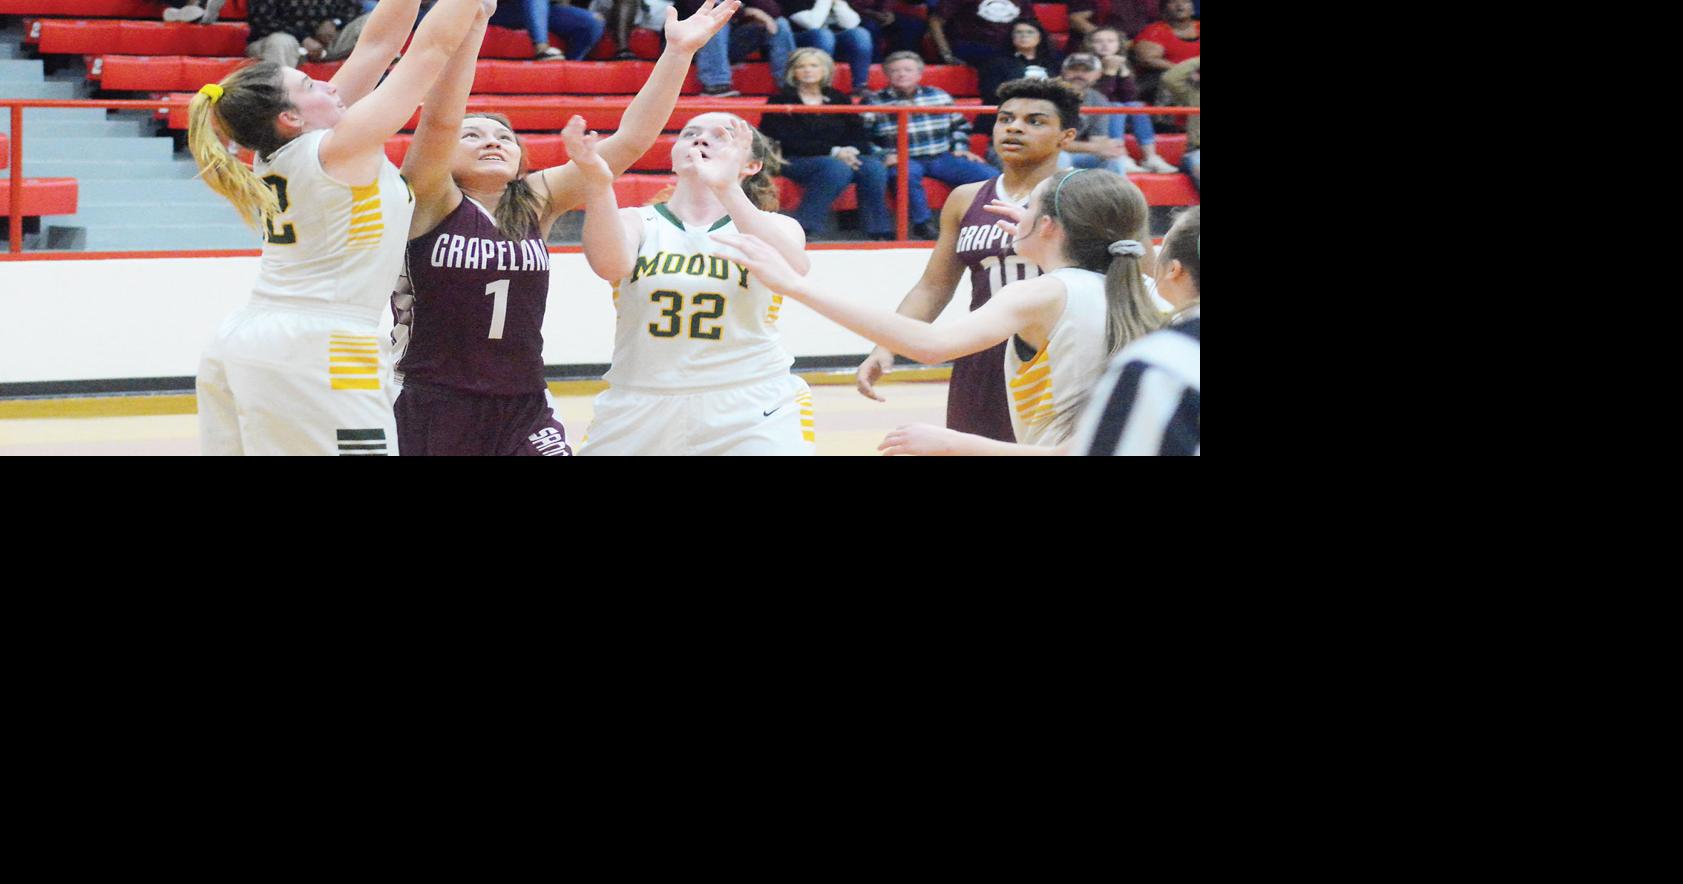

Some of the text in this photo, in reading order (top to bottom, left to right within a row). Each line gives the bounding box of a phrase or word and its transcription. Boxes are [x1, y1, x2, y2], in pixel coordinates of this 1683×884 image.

[257, 172, 297, 245] 2
[630, 251, 749, 289] MOODY
[484, 279, 511, 340] 1
[648, 289, 726, 341] 32
